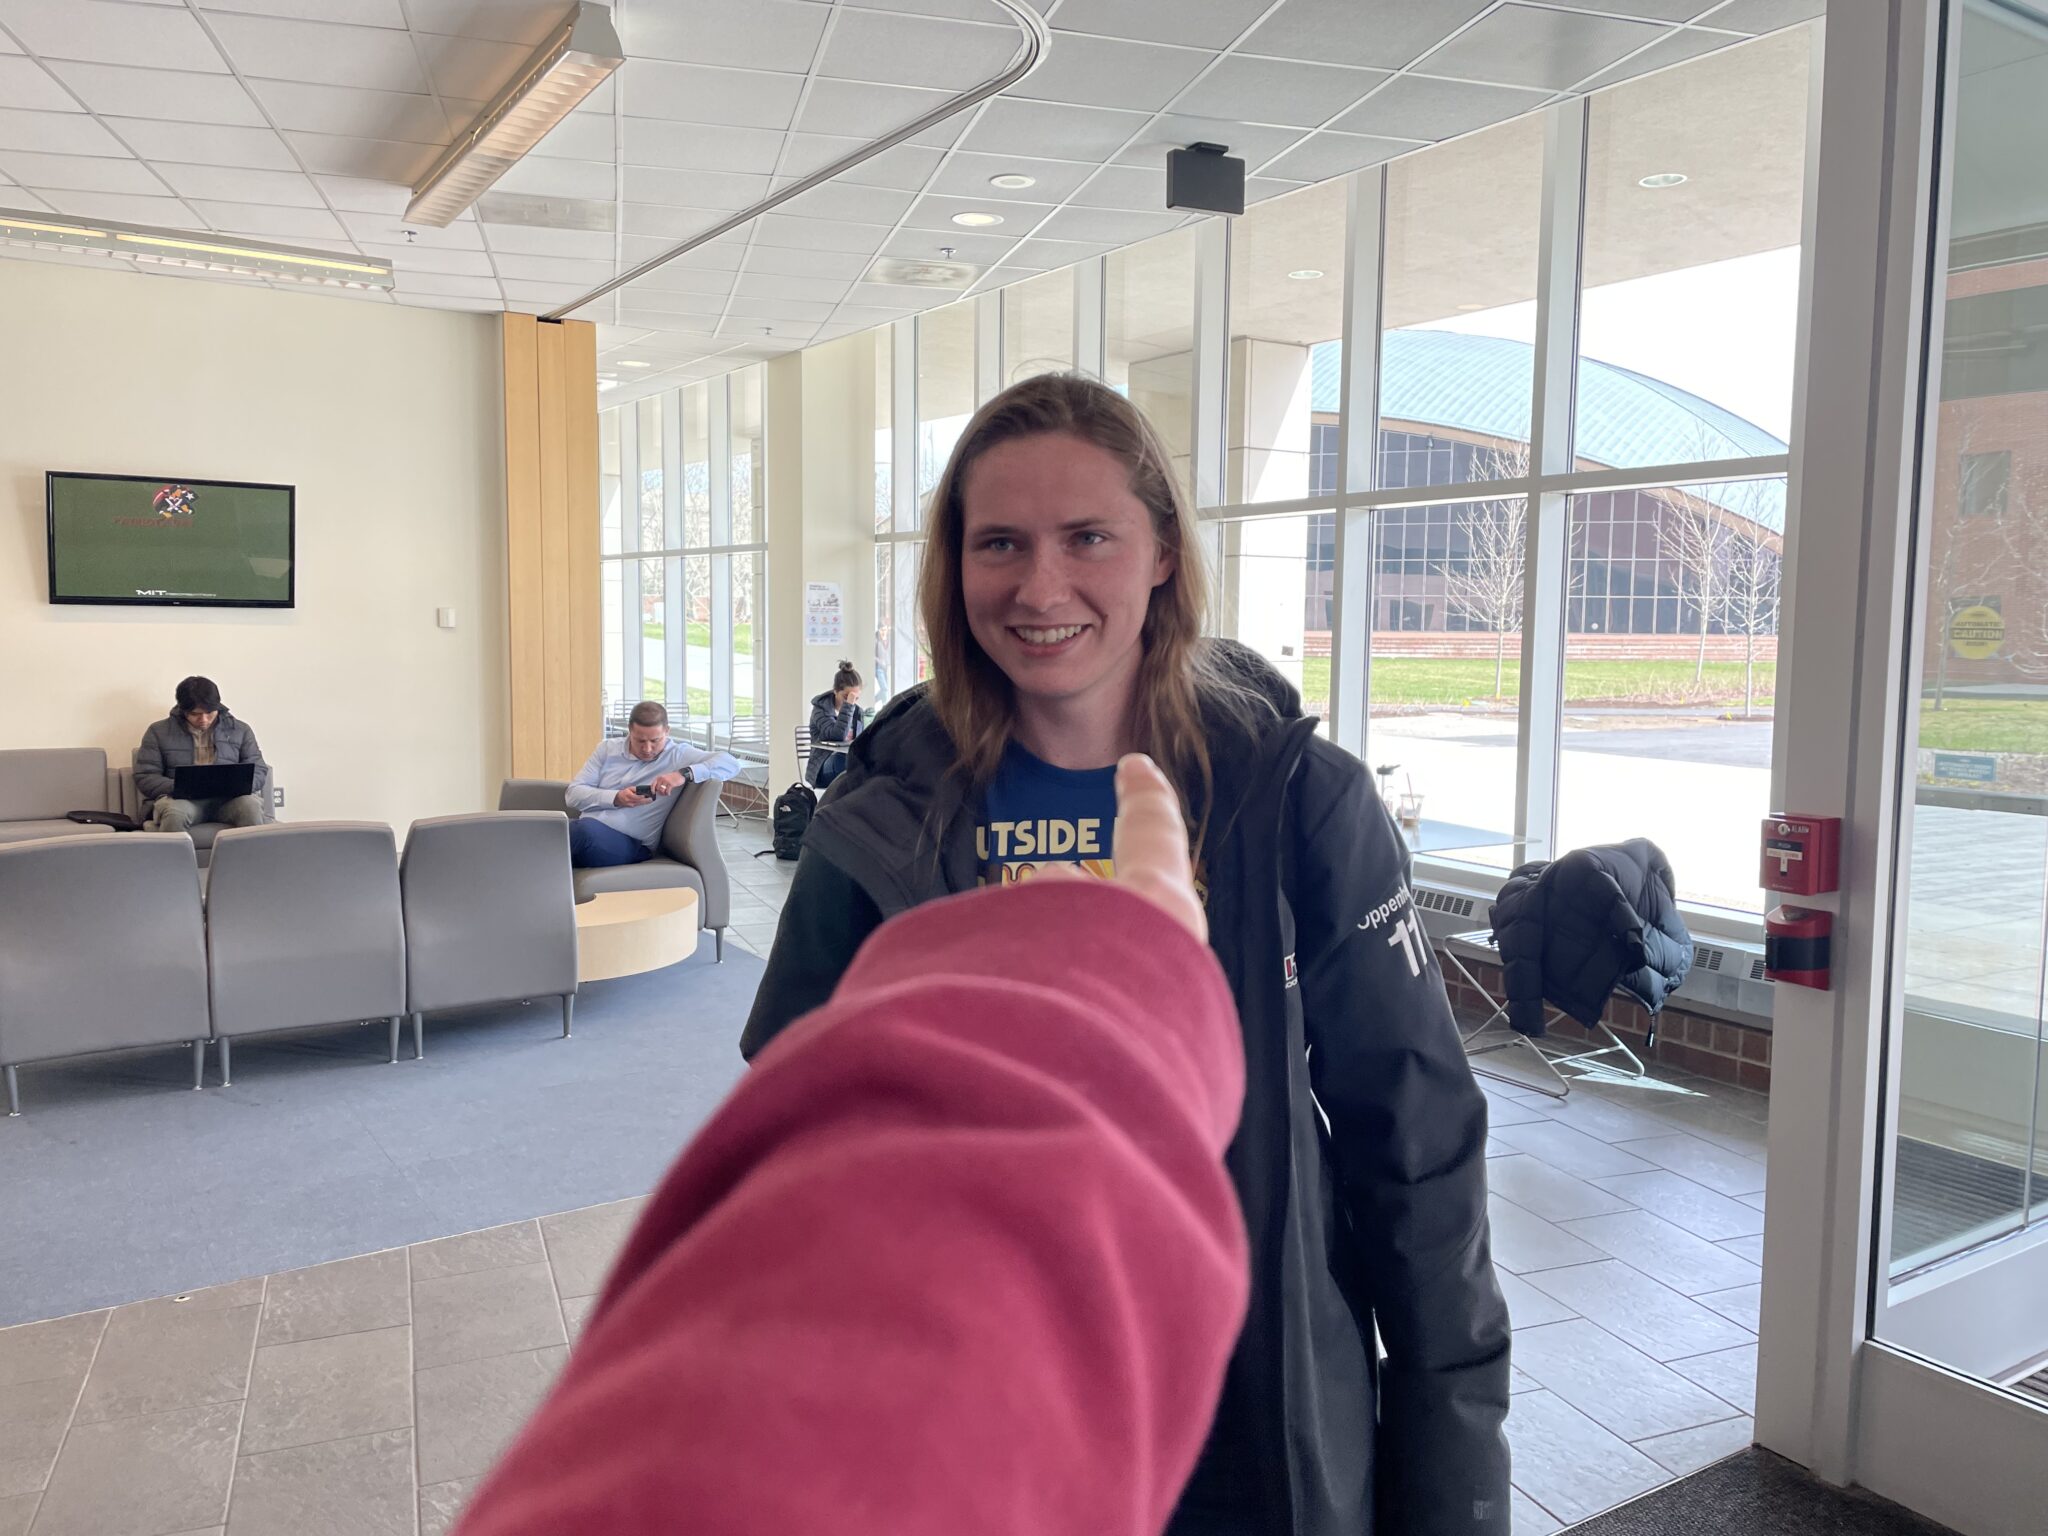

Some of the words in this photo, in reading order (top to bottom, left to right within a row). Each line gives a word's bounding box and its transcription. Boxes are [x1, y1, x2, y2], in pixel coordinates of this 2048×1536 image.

[1953, 629, 2002, 639] CAUTION
[976, 819, 1100, 861] UTSIDE
[1387, 908, 1428, 978] 11
